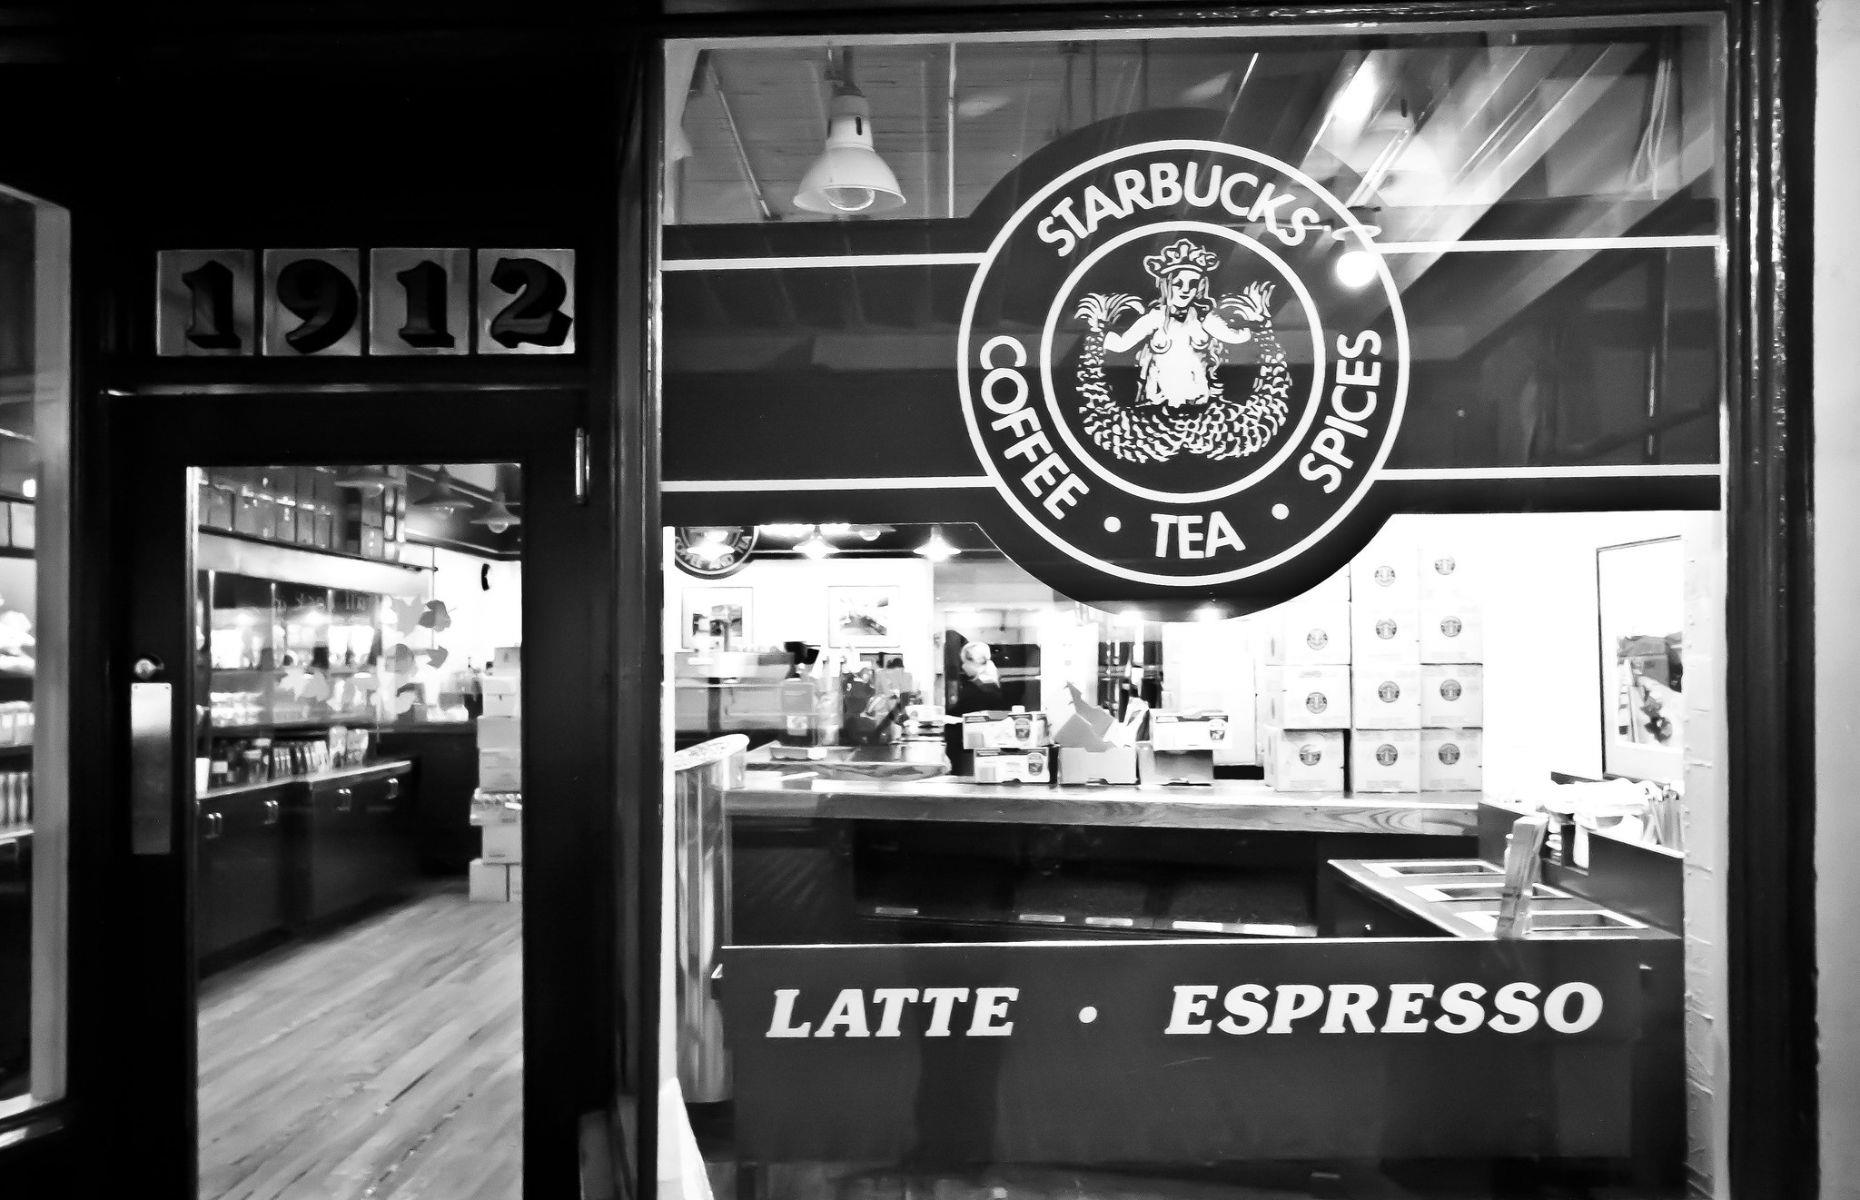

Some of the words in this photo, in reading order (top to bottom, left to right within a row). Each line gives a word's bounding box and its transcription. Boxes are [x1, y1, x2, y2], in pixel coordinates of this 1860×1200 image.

[1037, 161, 1320, 257] STARBUCKS
[182, 256, 574, 354] 1912
[979, 335, 1091, 521] COFFEE
[1150, 510, 1246, 560] TEA
[1298, 328, 1383, 495] SPICES
[765, 987, 1020, 1038] LATTE
[1164, 981, 1604, 1035] ESPRESSO
